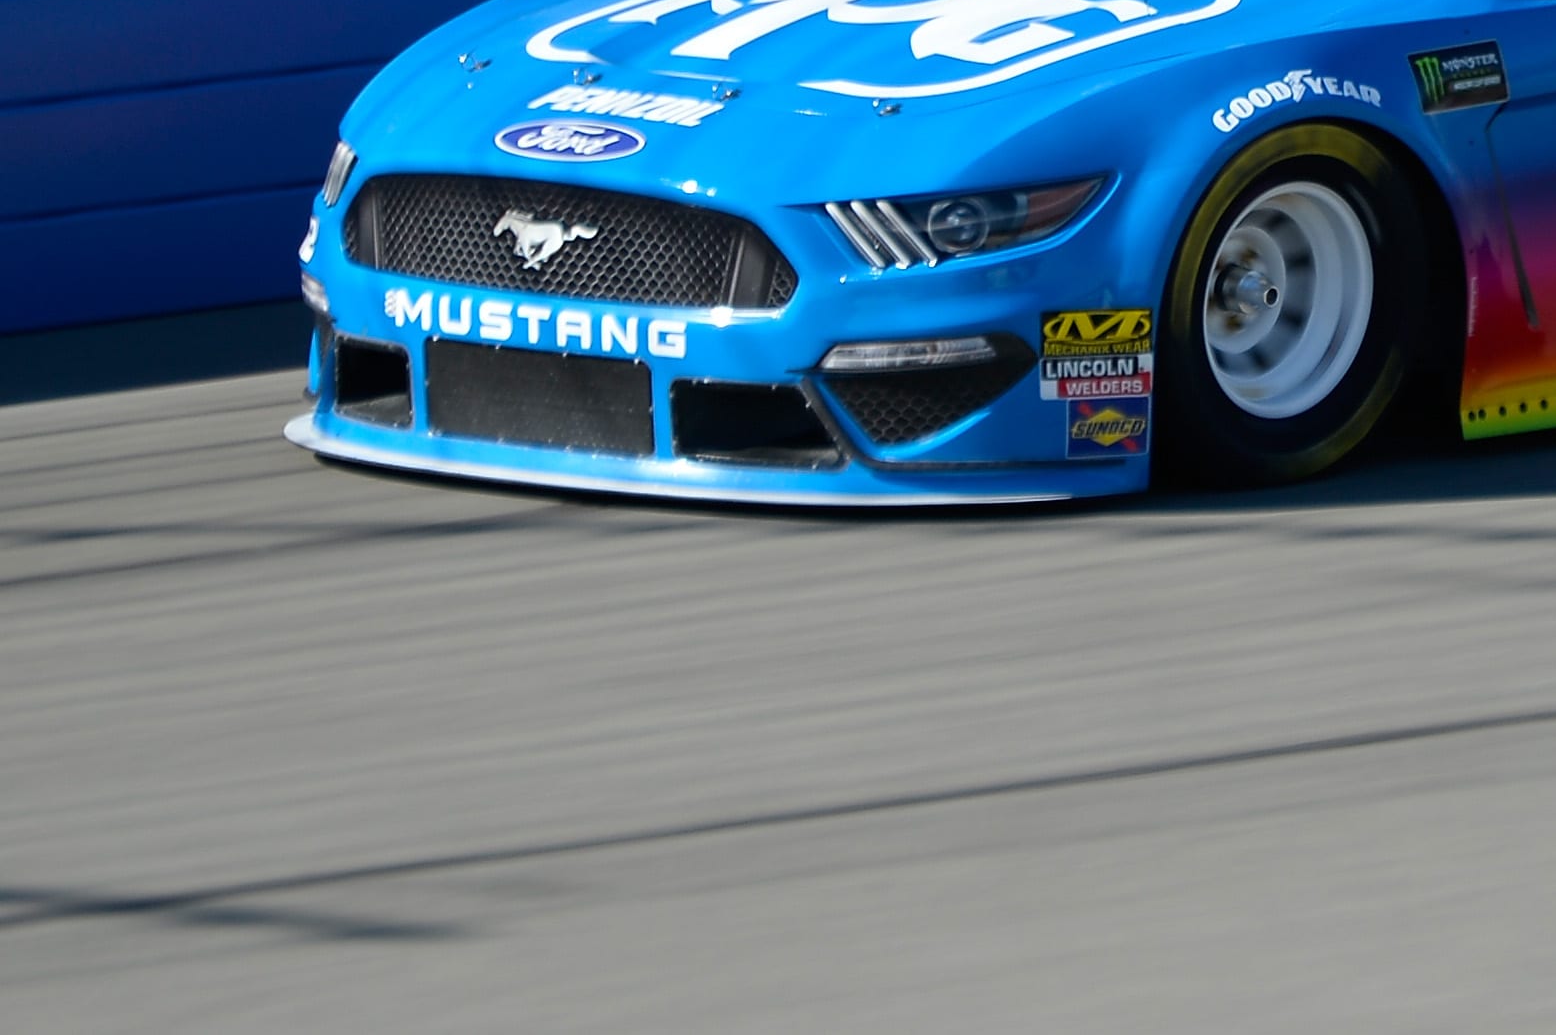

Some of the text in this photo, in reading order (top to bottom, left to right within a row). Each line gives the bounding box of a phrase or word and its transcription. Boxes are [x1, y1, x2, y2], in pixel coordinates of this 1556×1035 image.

[527, 84, 725, 128] PENNZOIL
[516, 123, 622, 157] Ford
[394, 288, 687, 359] MUSTANG
[1112, 339, 1150, 355] WEAR
[1046, 358, 1133, 379] LINCOLN
[1065, 379, 1143, 396] WELDERS
[1072, 419, 1146, 439] SUNOCO
